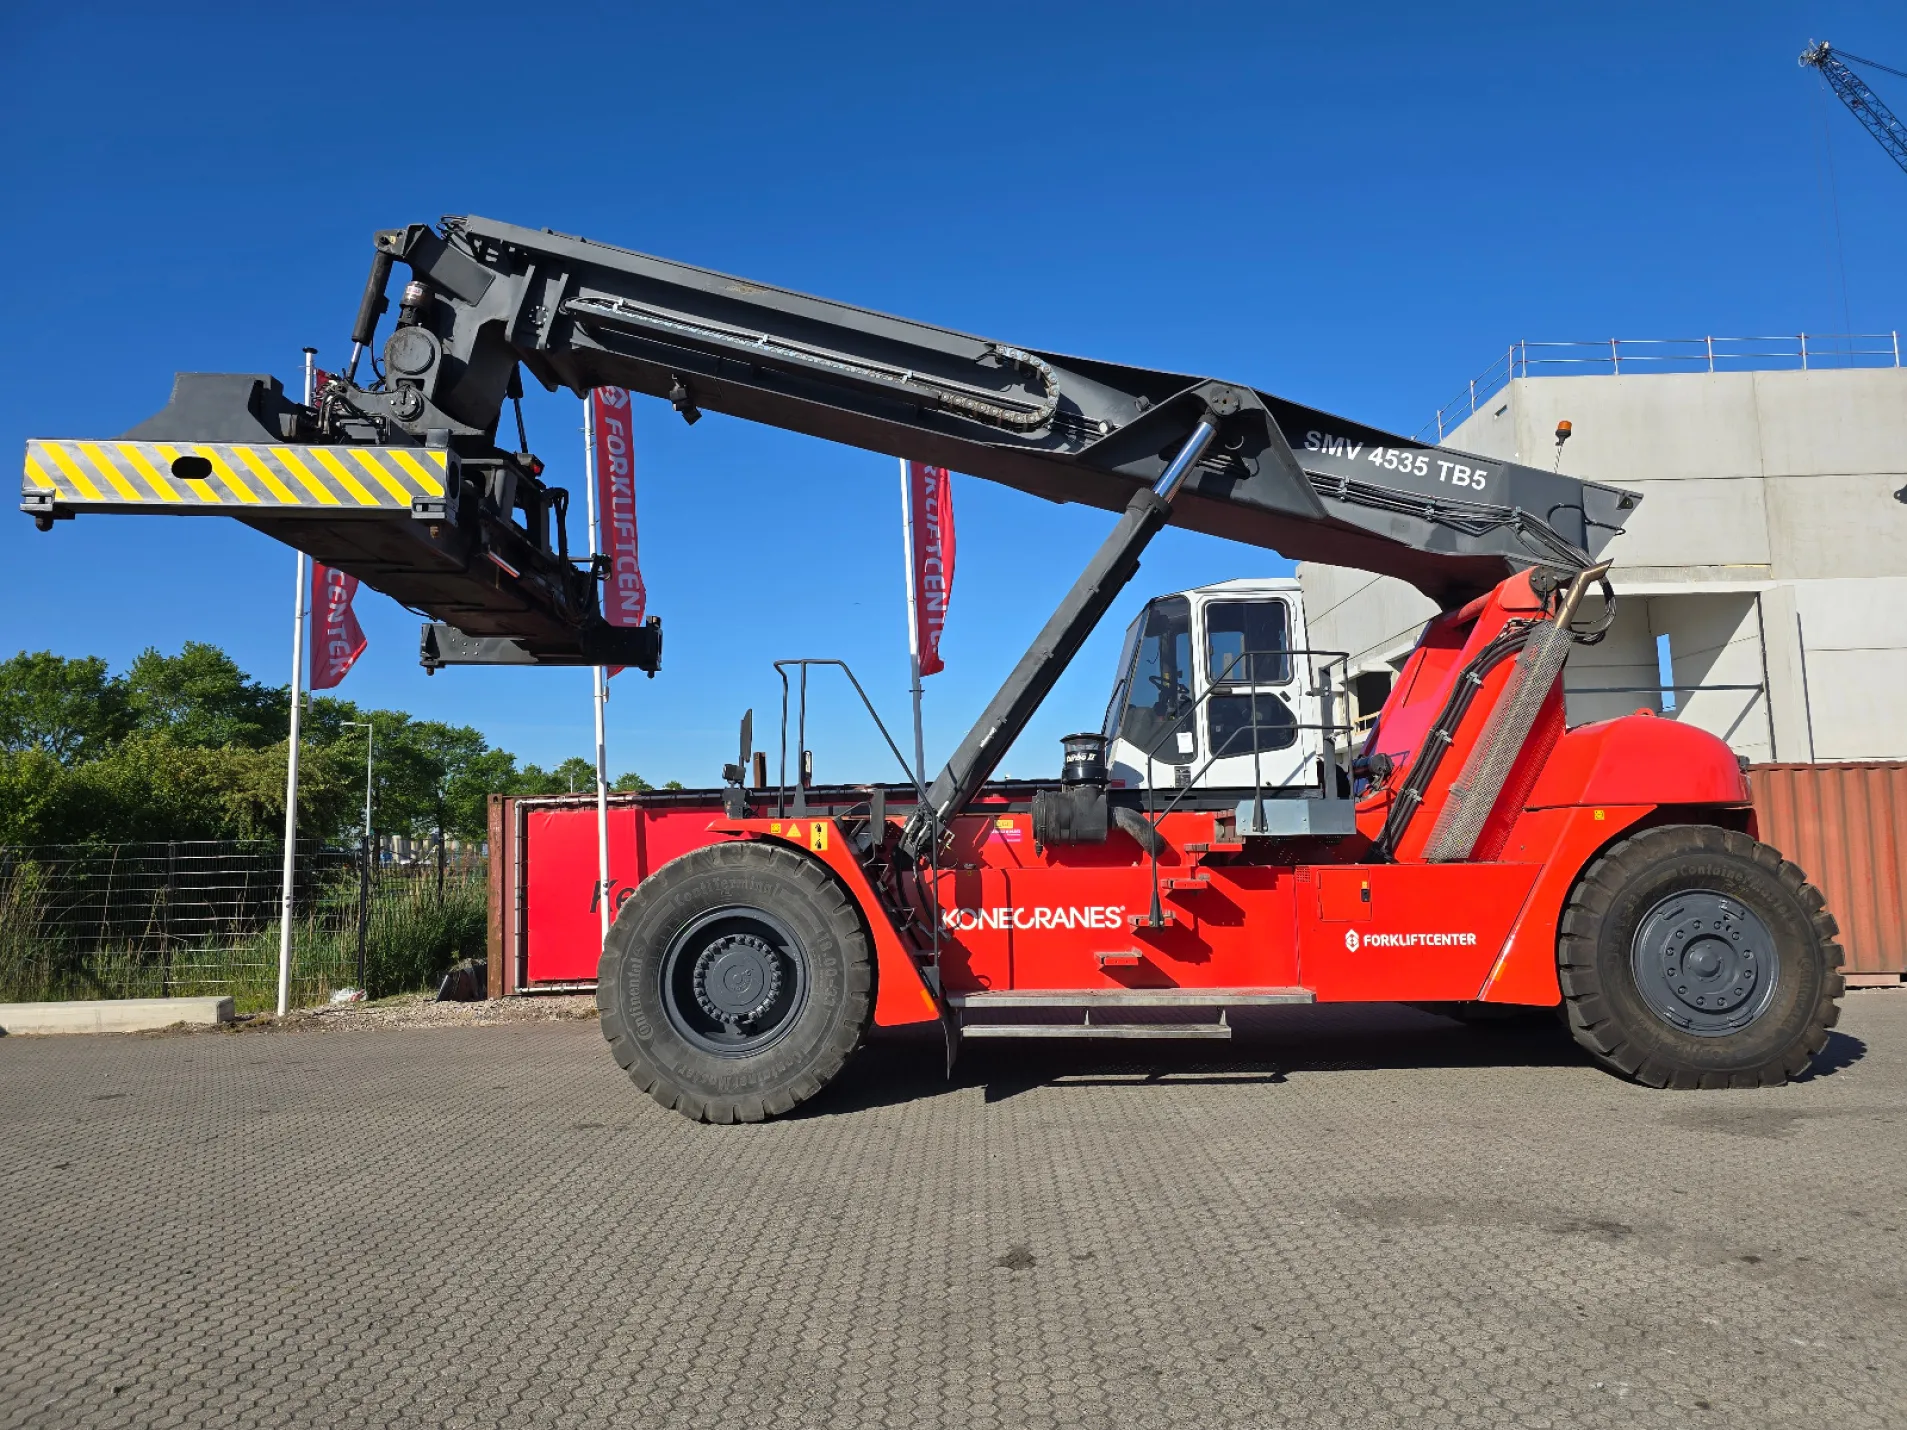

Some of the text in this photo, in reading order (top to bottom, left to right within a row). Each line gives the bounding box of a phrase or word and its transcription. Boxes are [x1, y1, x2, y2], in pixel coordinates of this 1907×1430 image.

[1304, 430, 1488, 491] SMV 4535 TB5
[941, 906, 1123, 930] KONECRANES
[1363, 932, 1477, 947] FORKLIFTCENTER
[629, 957, 653, 1040] Continental
